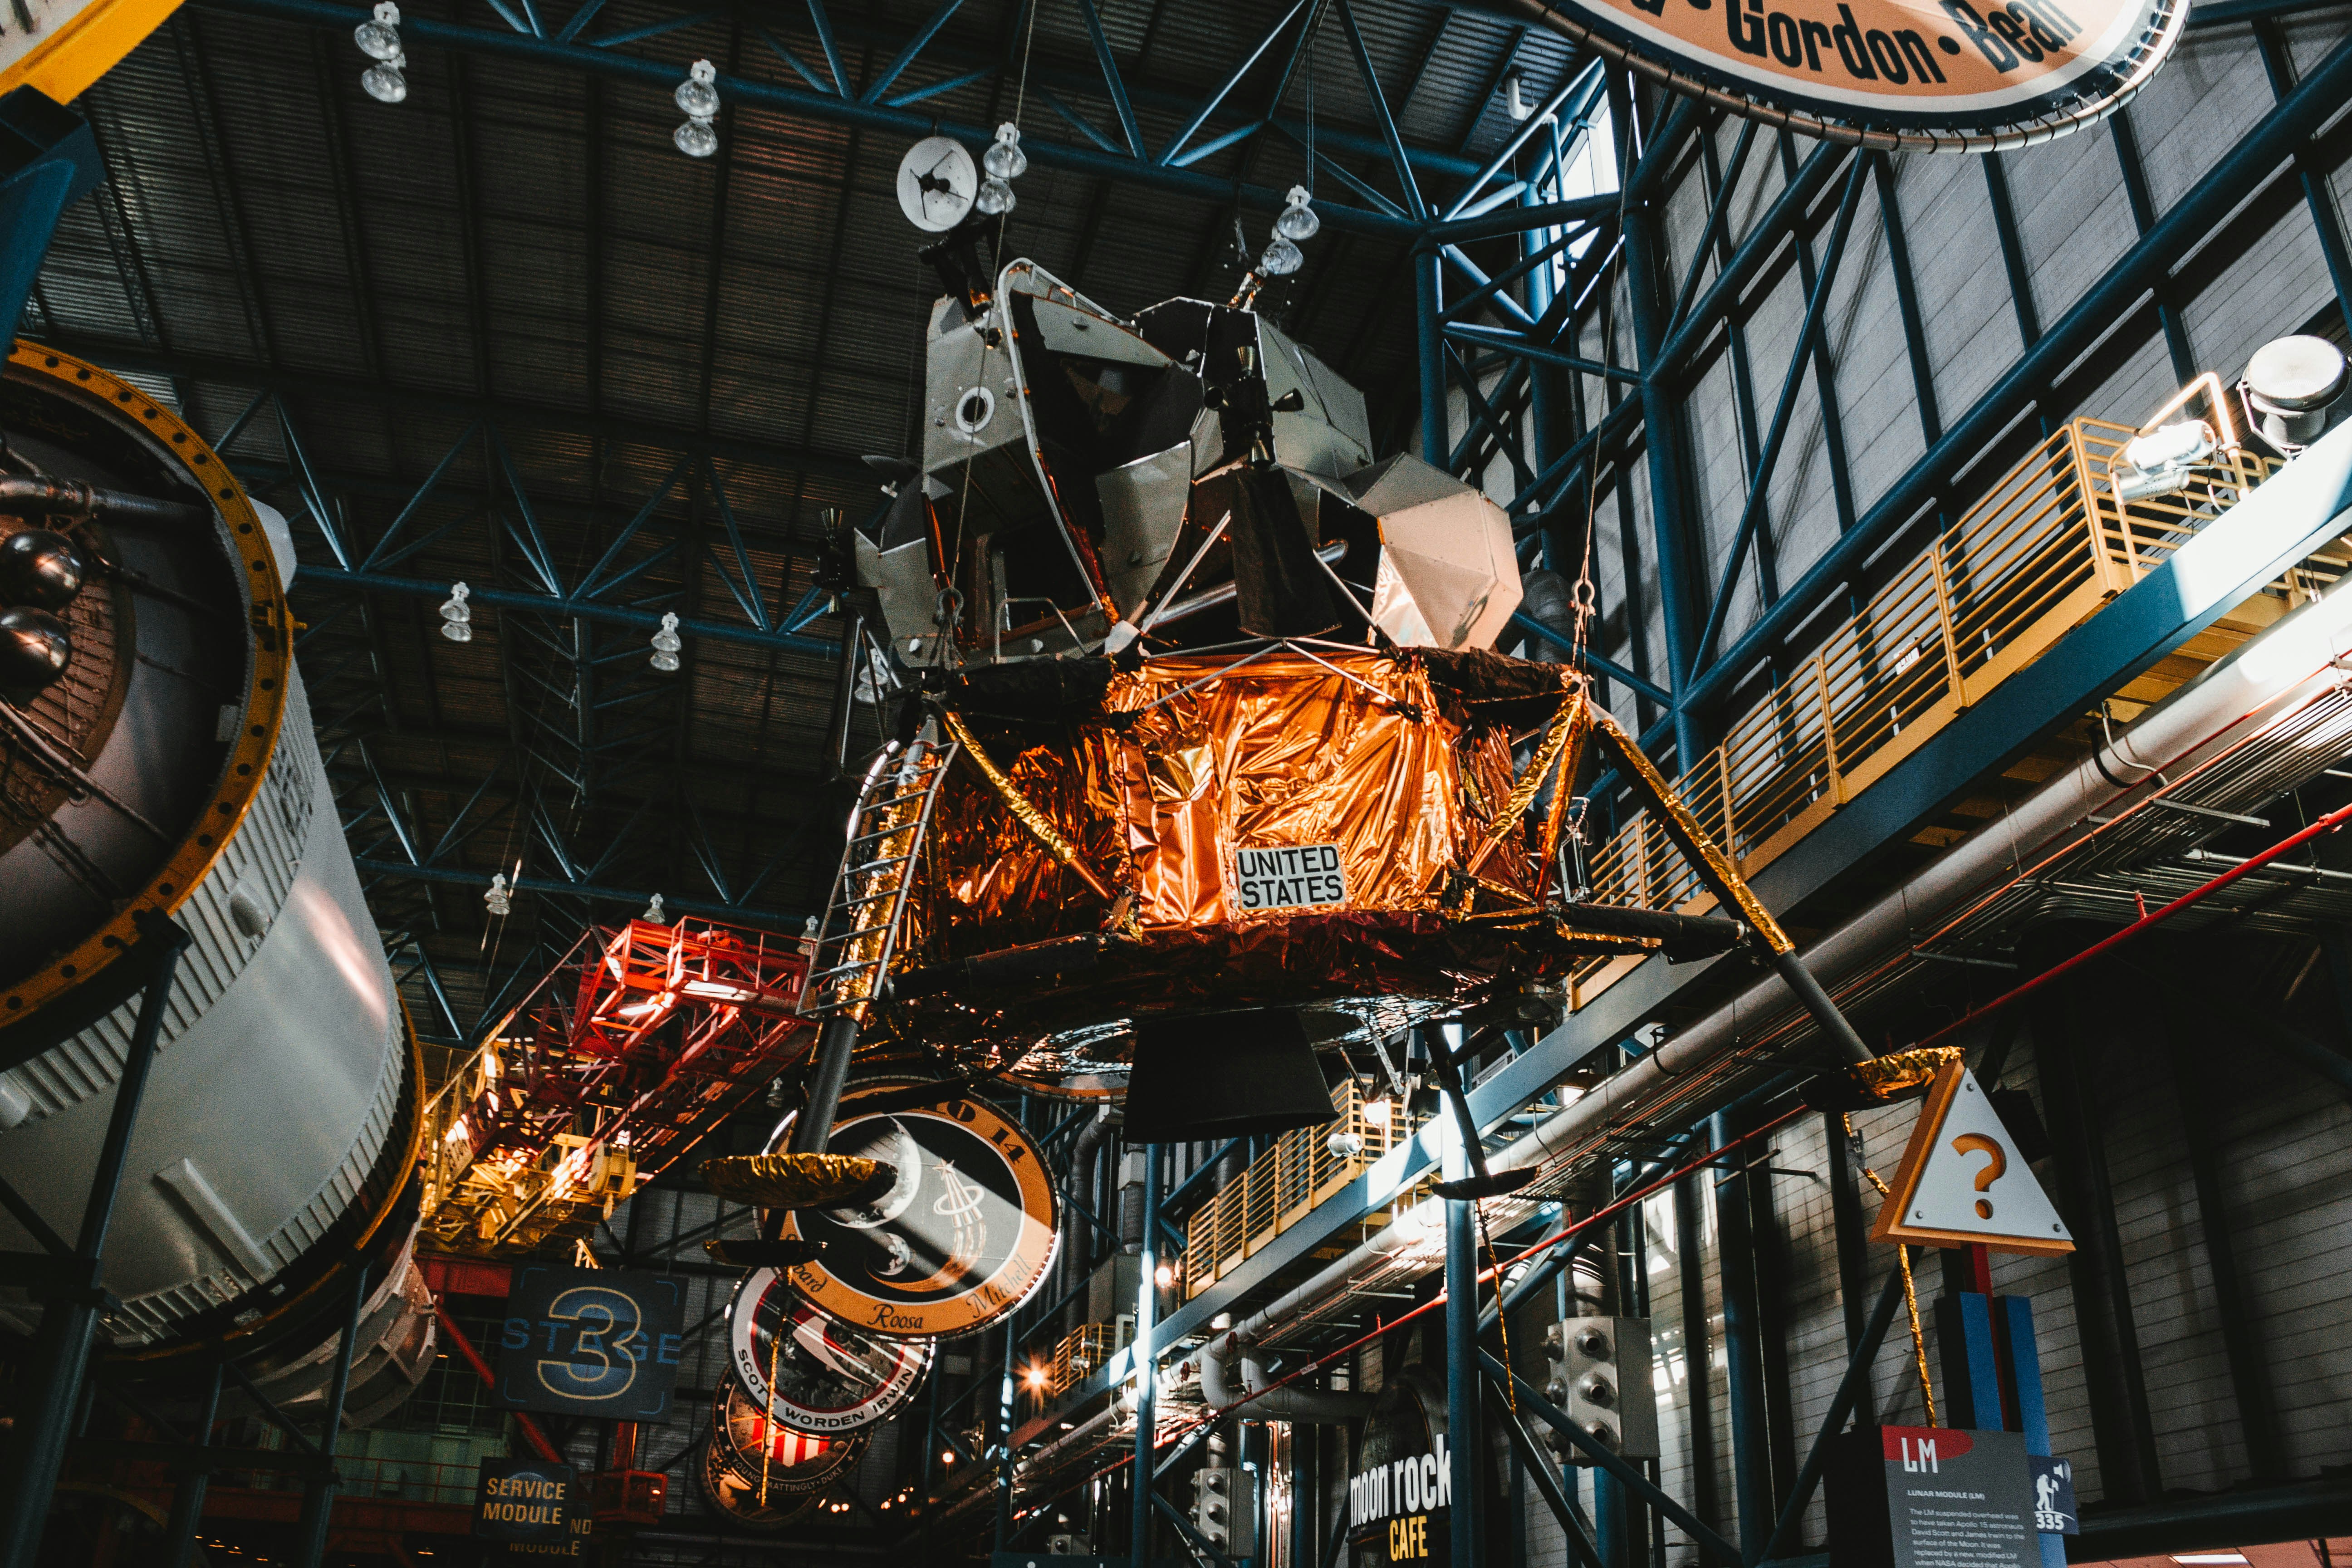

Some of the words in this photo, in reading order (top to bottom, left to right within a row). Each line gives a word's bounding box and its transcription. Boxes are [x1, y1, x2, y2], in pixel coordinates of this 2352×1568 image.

[1726, 0, 1947, 85] Gordon
[1938, 0, 2083, 74] Bean
[1238, 846, 1339, 877] UNITED
[1241, 875, 1343, 907] STATES
[990, 1127, 1026, 1164] 14
[867, 1303, 923, 1329] Roosa
[965, 1254, 1031, 1318] Mitchell
[500, 1317, 682, 1365] STAGE
[537, 1286, 642, 1400] 3
[738, 1348, 778, 1402] SCOT
[785, 1406, 865, 1427] WORDEN
[872, 1368, 913, 1413] IRWIN
[732, 1457, 762, 1484] YOUNG
[821, 1466, 844, 1485] DUKE
[1901, 1437, 1938, 1474] LM
[486, 1477, 567, 1500] SERVICE
[1350, 1464, 1388, 1528] moon
[1394, 1433, 1451, 1514] rock
[482, 1502, 563, 1525] MODULE
[2036, 1513, 2064, 1530] 335
[1389, 1515, 1428, 1562] CAFE
